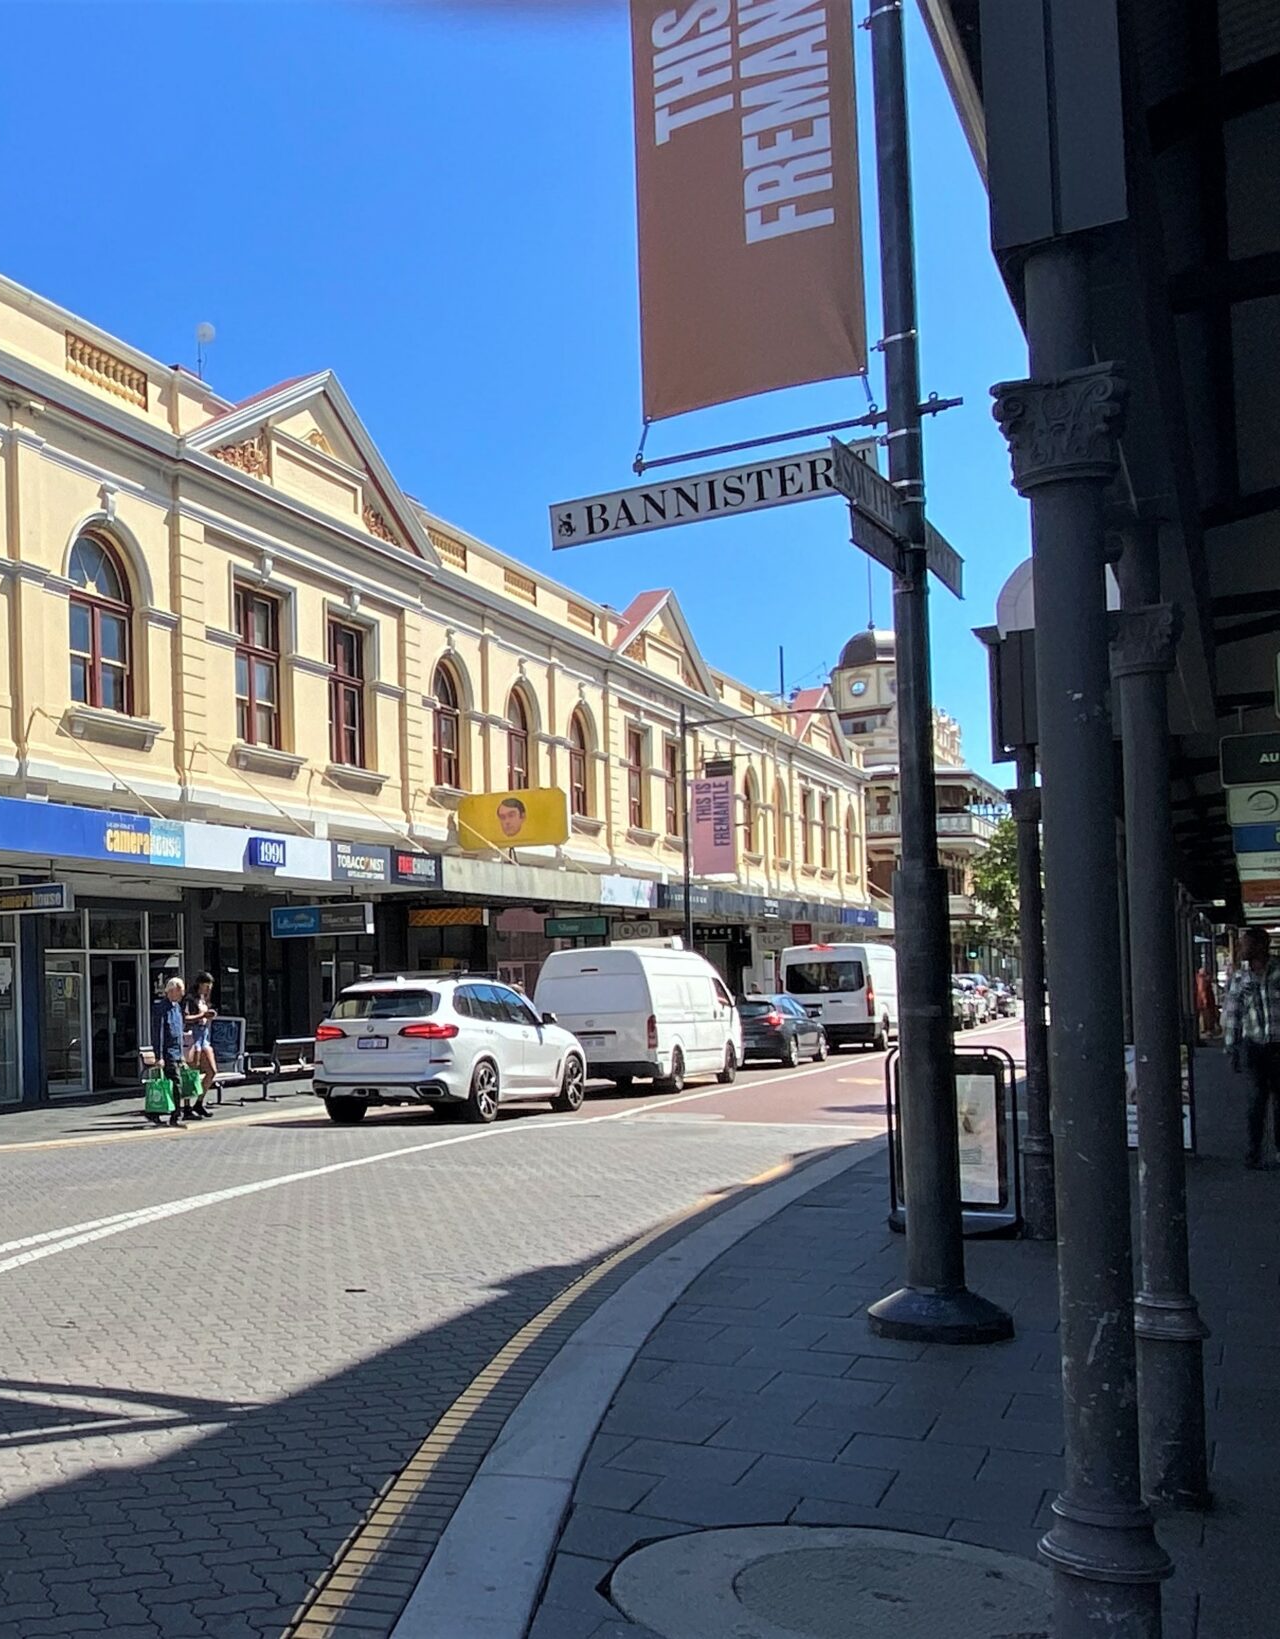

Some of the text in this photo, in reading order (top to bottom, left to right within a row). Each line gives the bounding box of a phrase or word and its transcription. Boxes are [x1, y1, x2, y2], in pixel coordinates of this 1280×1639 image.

[650, 0, 733, 146] THIS
[738, 0, 835, 245] FREMAN
[584, 456, 833, 537] BANNISTER
[695, 782, 712, 823] THIS IS
[713, 780, 731, 847] FREMANTLE
[259, 840, 285, 866] 1991
